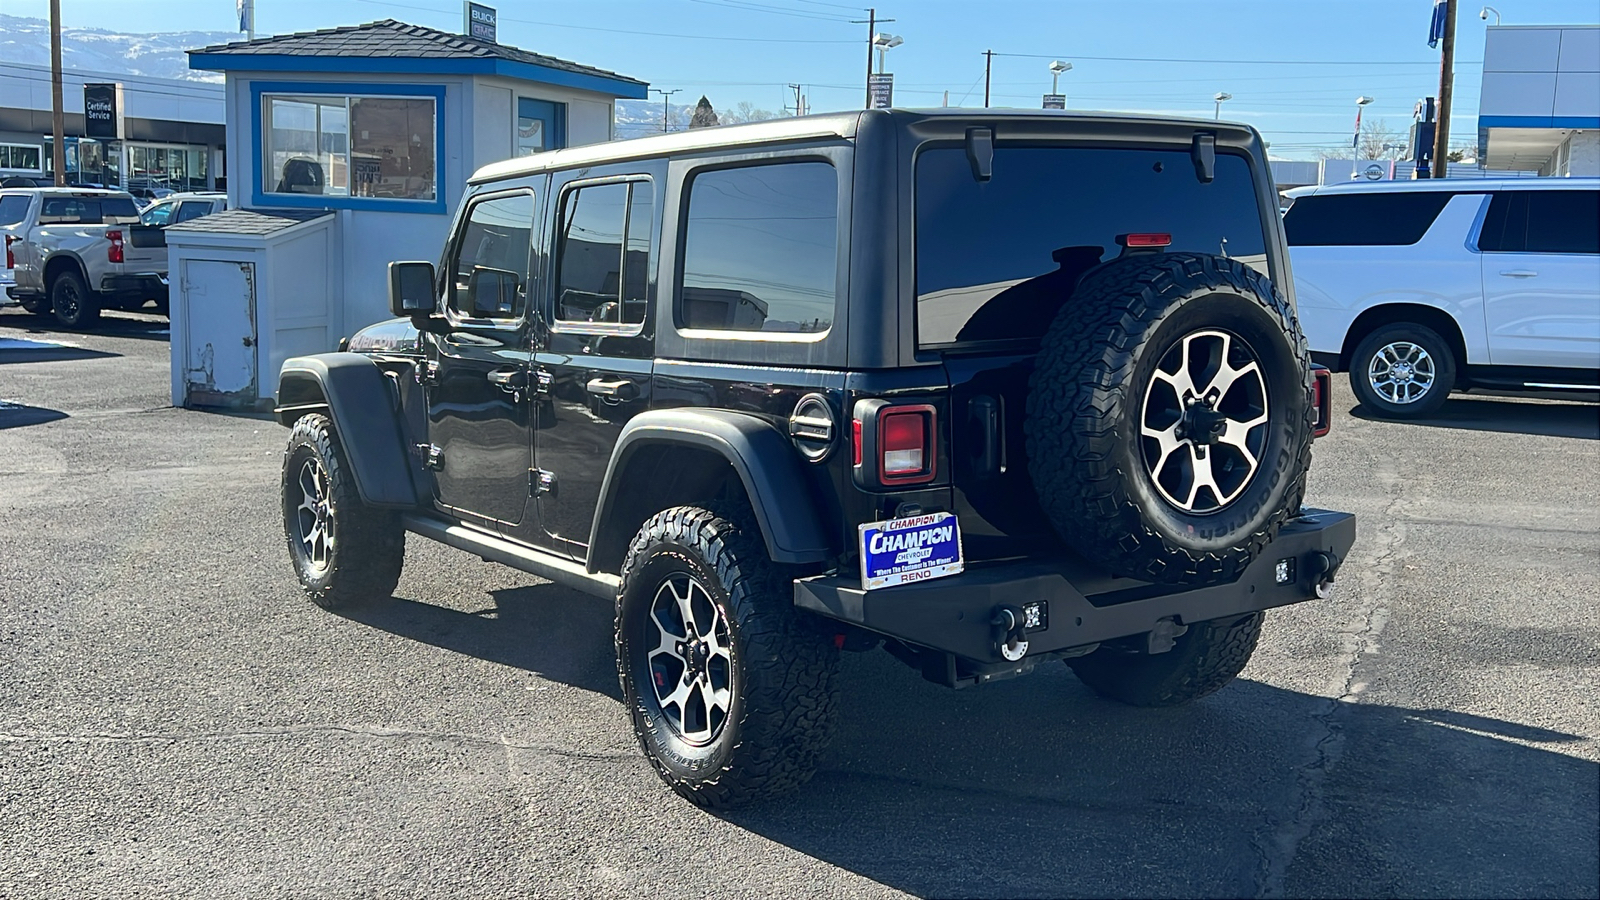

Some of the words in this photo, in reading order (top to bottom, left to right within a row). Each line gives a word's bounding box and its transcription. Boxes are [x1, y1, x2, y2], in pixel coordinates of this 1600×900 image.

[472, 10, 495, 24] BUICK
[473, 24, 495, 37] GMC
[87, 101, 112, 111] Certified
[88, 110, 111, 120] Service
[349, 334, 398, 350] RUBICON
[889, 514, 936, 530] CHAMPION
[869, 525, 953, 555] CHAMPION
[897, 549, 931, 561] CHEVROLET
[892, 565, 901, 574] The
[928, 558, 936, 567] The
[900, 570, 932, 583] RENO
